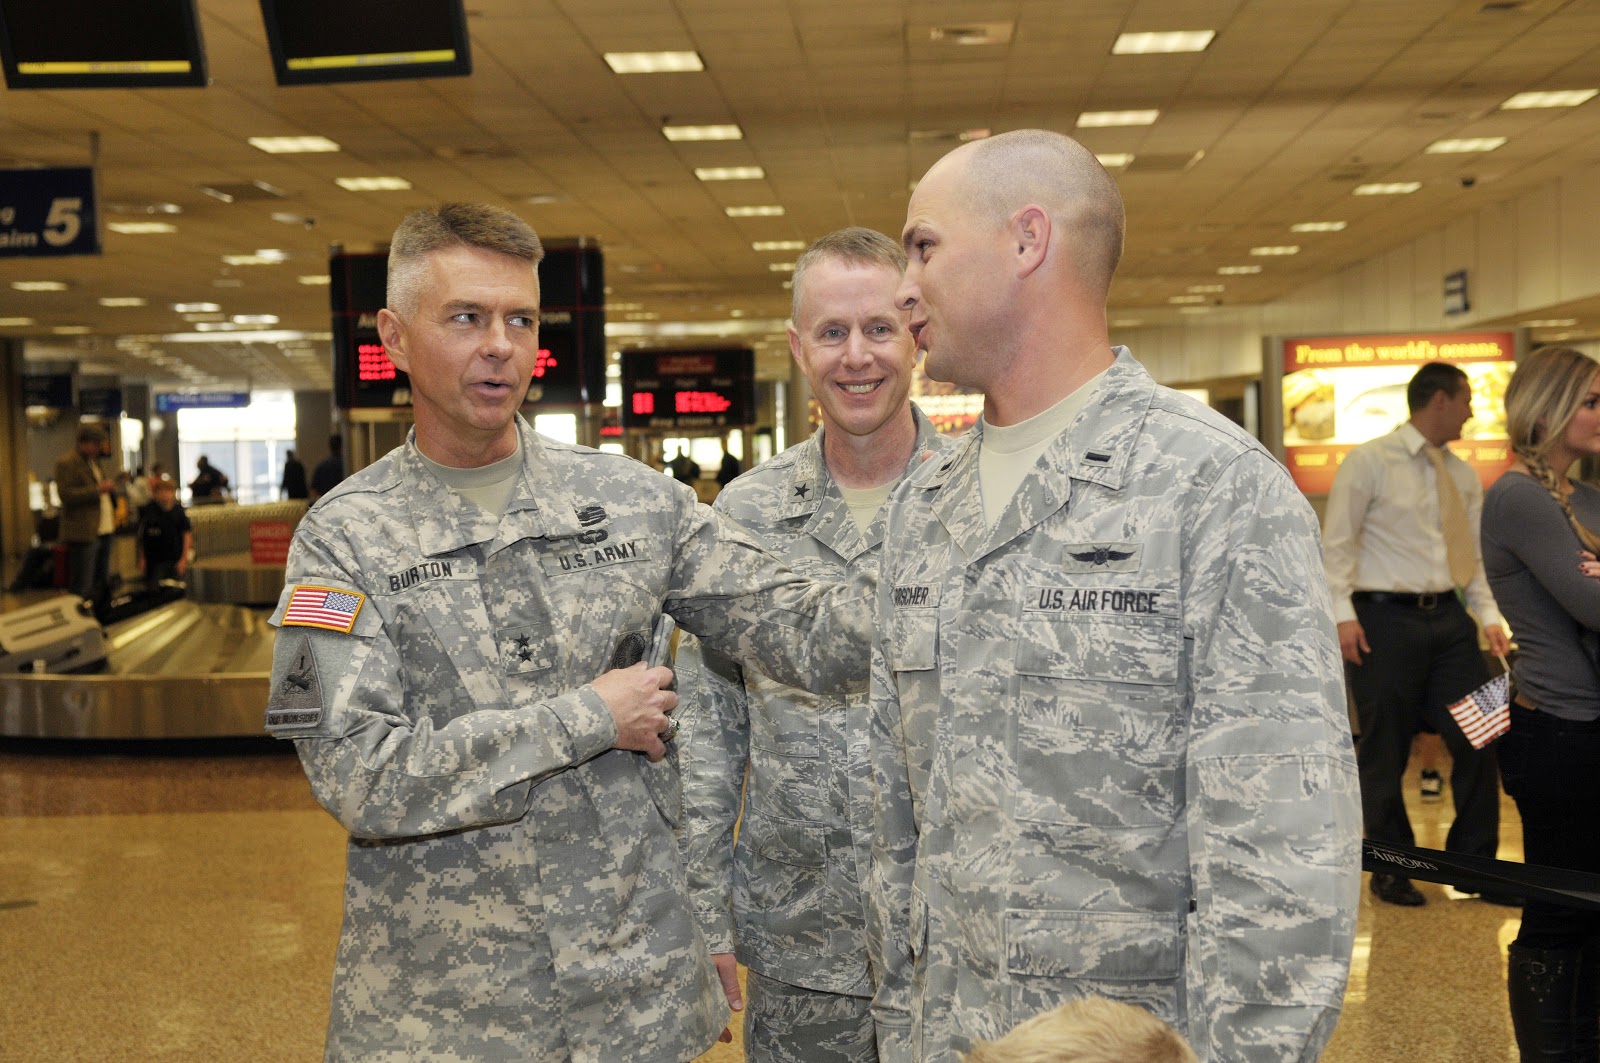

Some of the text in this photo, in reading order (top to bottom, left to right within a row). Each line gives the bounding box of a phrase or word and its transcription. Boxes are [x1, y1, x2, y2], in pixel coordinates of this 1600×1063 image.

[42, 198, 82, 247] 5
[1296, 345, 1342, 363] From
[1345, 343, 1374, 361] the
[1376, 340, 1437, 360] world's
[558, 541, 638, 571] U.S. ARMY
[389, 561, 453, 592] BURTON
[1038, 589, 1161, 614] U.S. AIR FORCE
[1366, 848, 1439, 871] AIRPORTS
